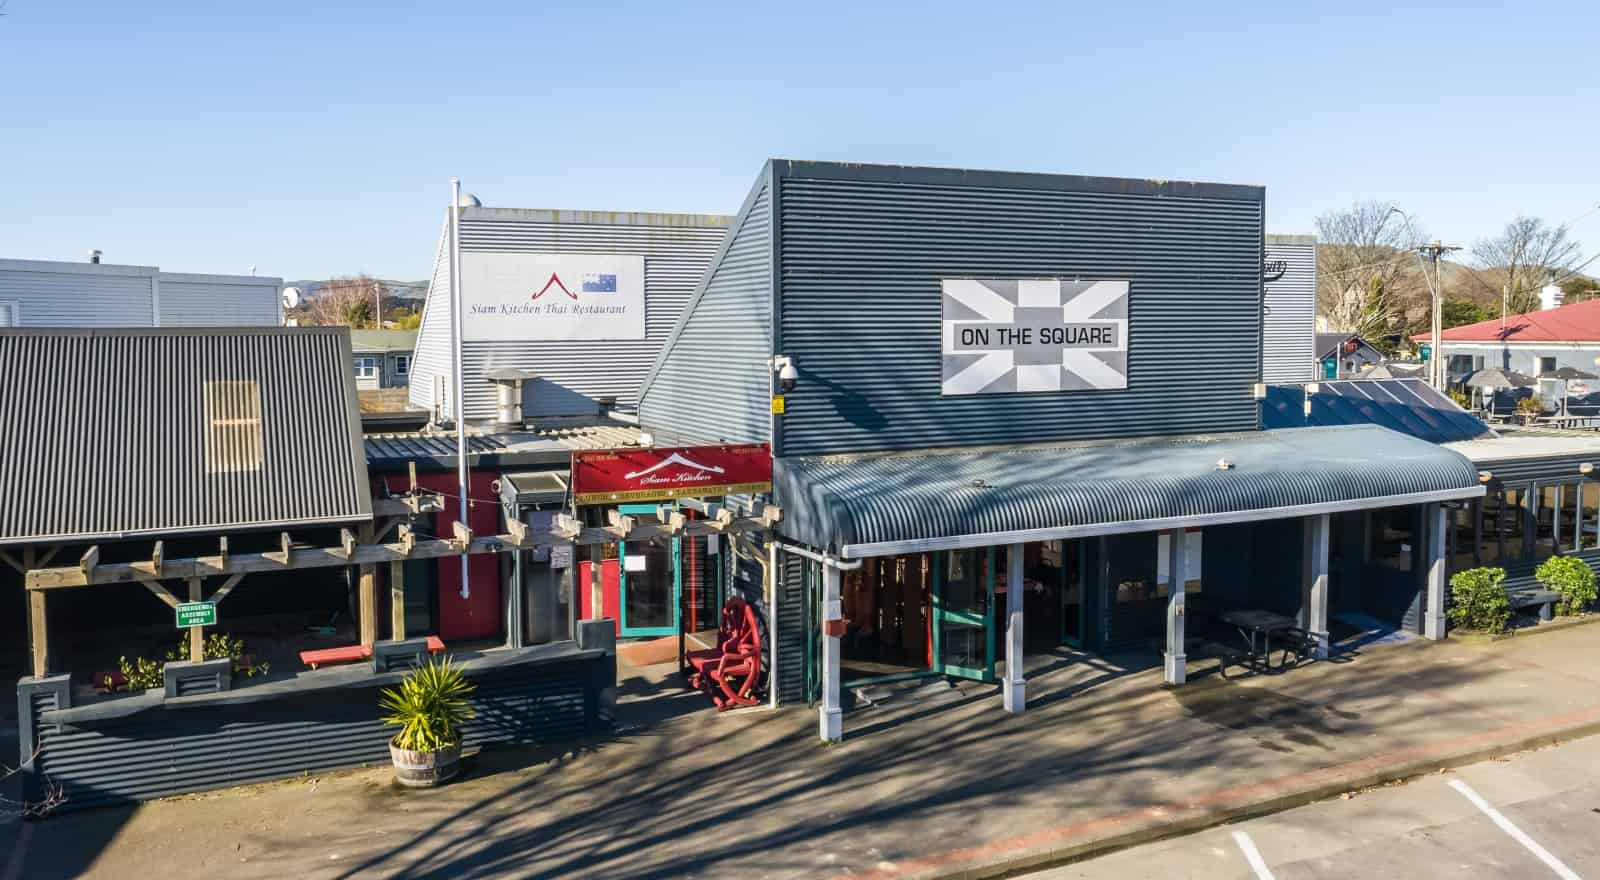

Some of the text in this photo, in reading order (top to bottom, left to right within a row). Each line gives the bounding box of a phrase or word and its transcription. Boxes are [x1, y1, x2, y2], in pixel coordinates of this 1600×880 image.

[470, 303, 627, 315] Siam Kitchen Thai Restaurant
[961, 327, 1112, 345] ON THE SQUARE
[640, 470, 712, 486] Siam Kitchen
